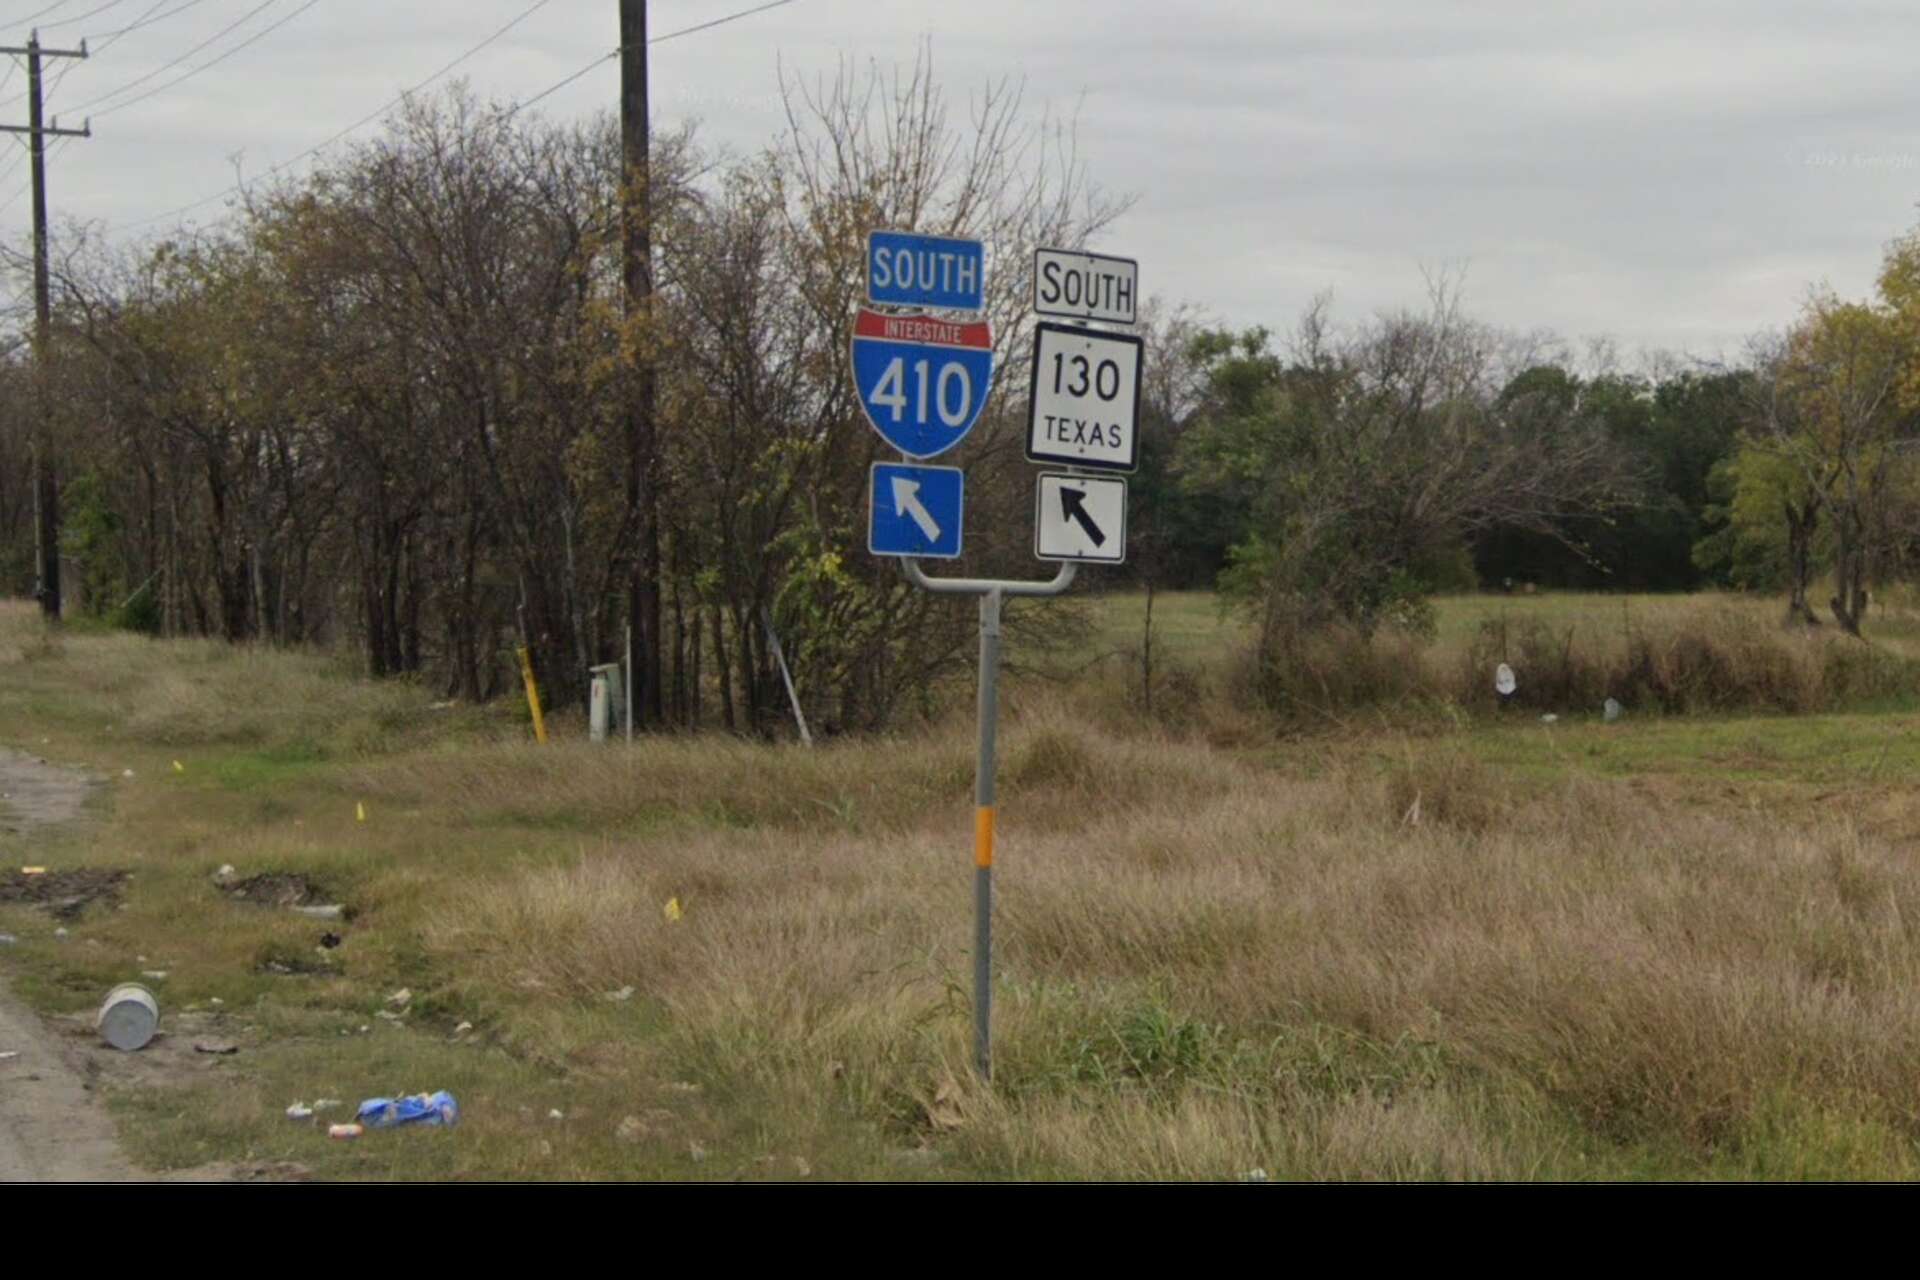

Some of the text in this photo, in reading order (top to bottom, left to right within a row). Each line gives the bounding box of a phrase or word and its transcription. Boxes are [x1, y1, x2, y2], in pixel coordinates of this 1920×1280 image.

[872, 247, 976, 294] SOUTH
[1041, 260, 1131, 312] SOUTH
[884, 319, 961, 343] INTERSTATE
[868, 357, 971, 427] 410
[1054, 352, 1120, 402] 130
[1044, 415, 1122, 448] TEXAS
